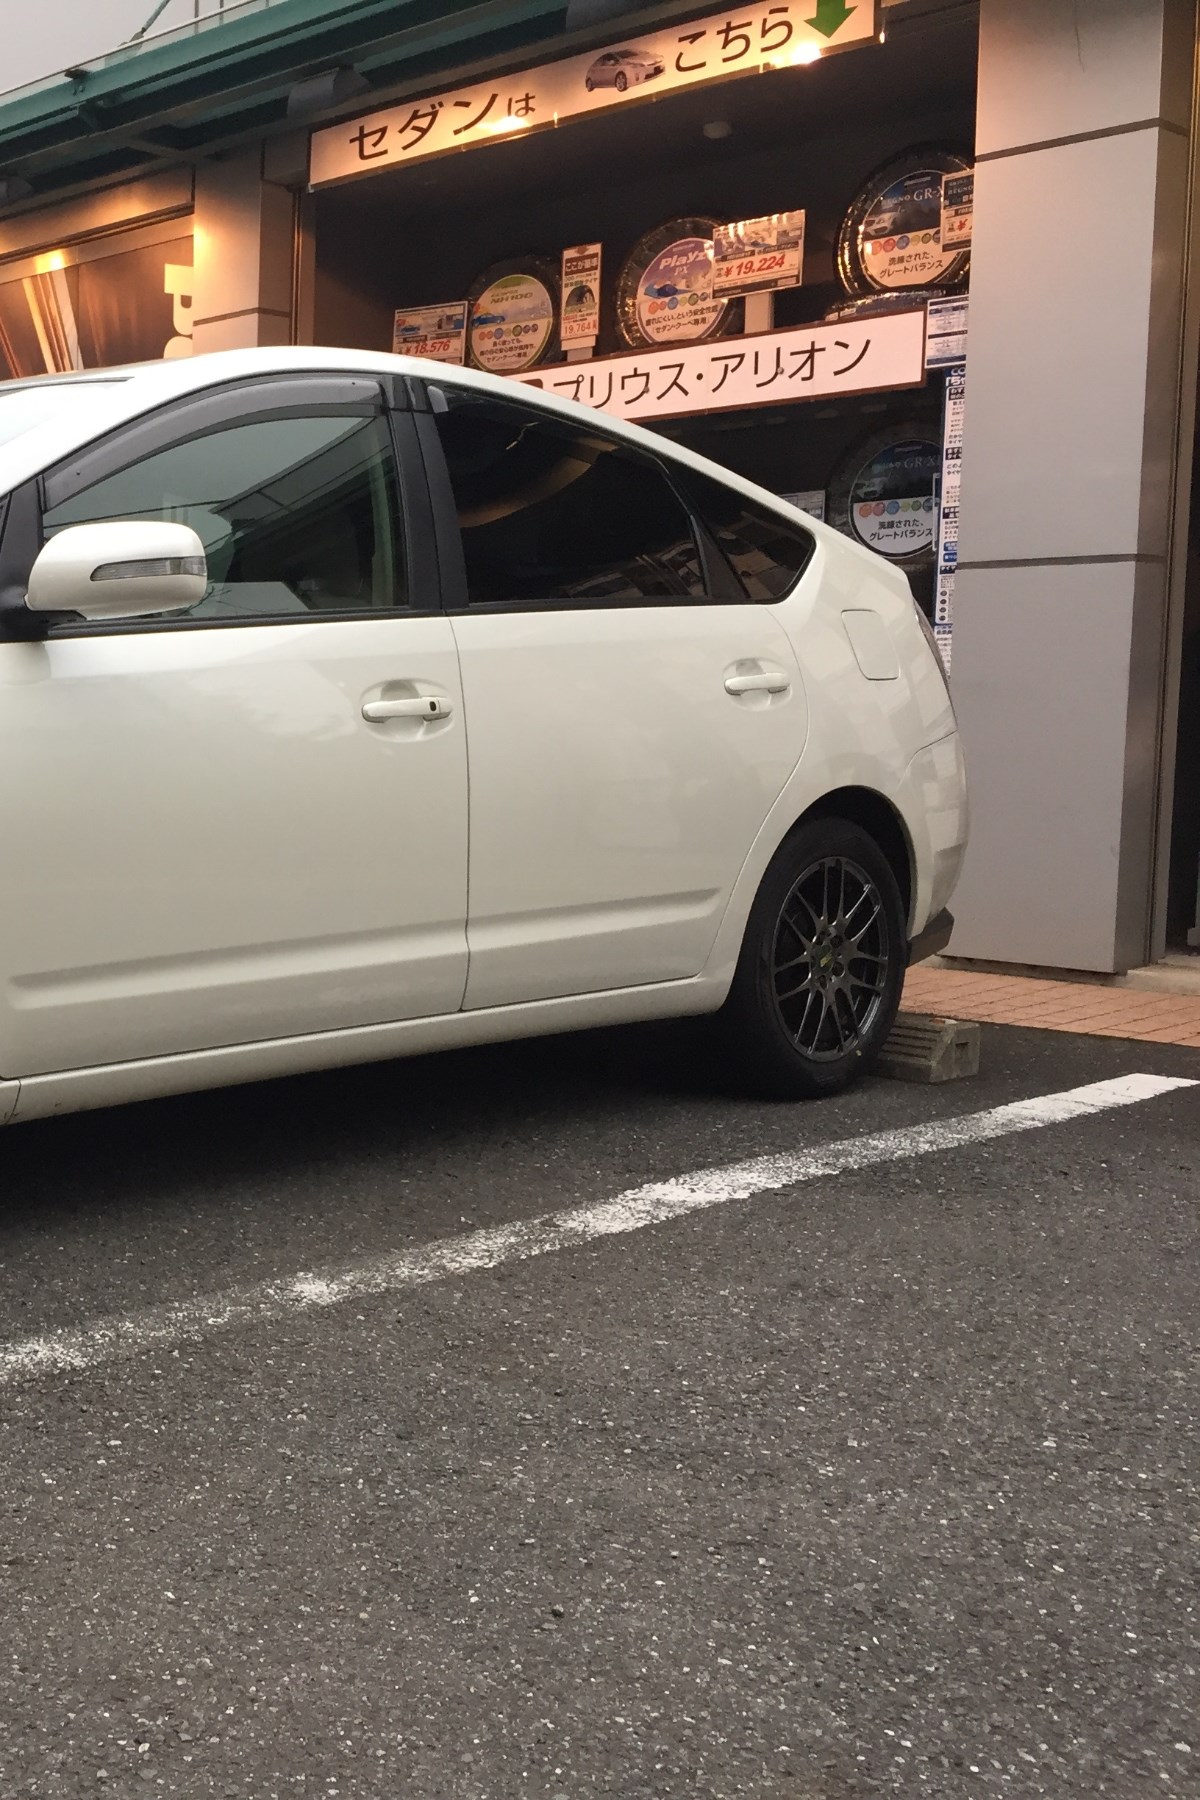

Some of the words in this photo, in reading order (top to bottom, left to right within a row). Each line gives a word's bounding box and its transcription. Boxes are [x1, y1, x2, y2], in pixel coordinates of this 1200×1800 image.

[349, 92, 536, 162] セダンは
[675, 6, 794, 73] こちら
[879, 260, 944, 278] グレートバランス
[553, 339, 871, 409] プリウス・アリオン
